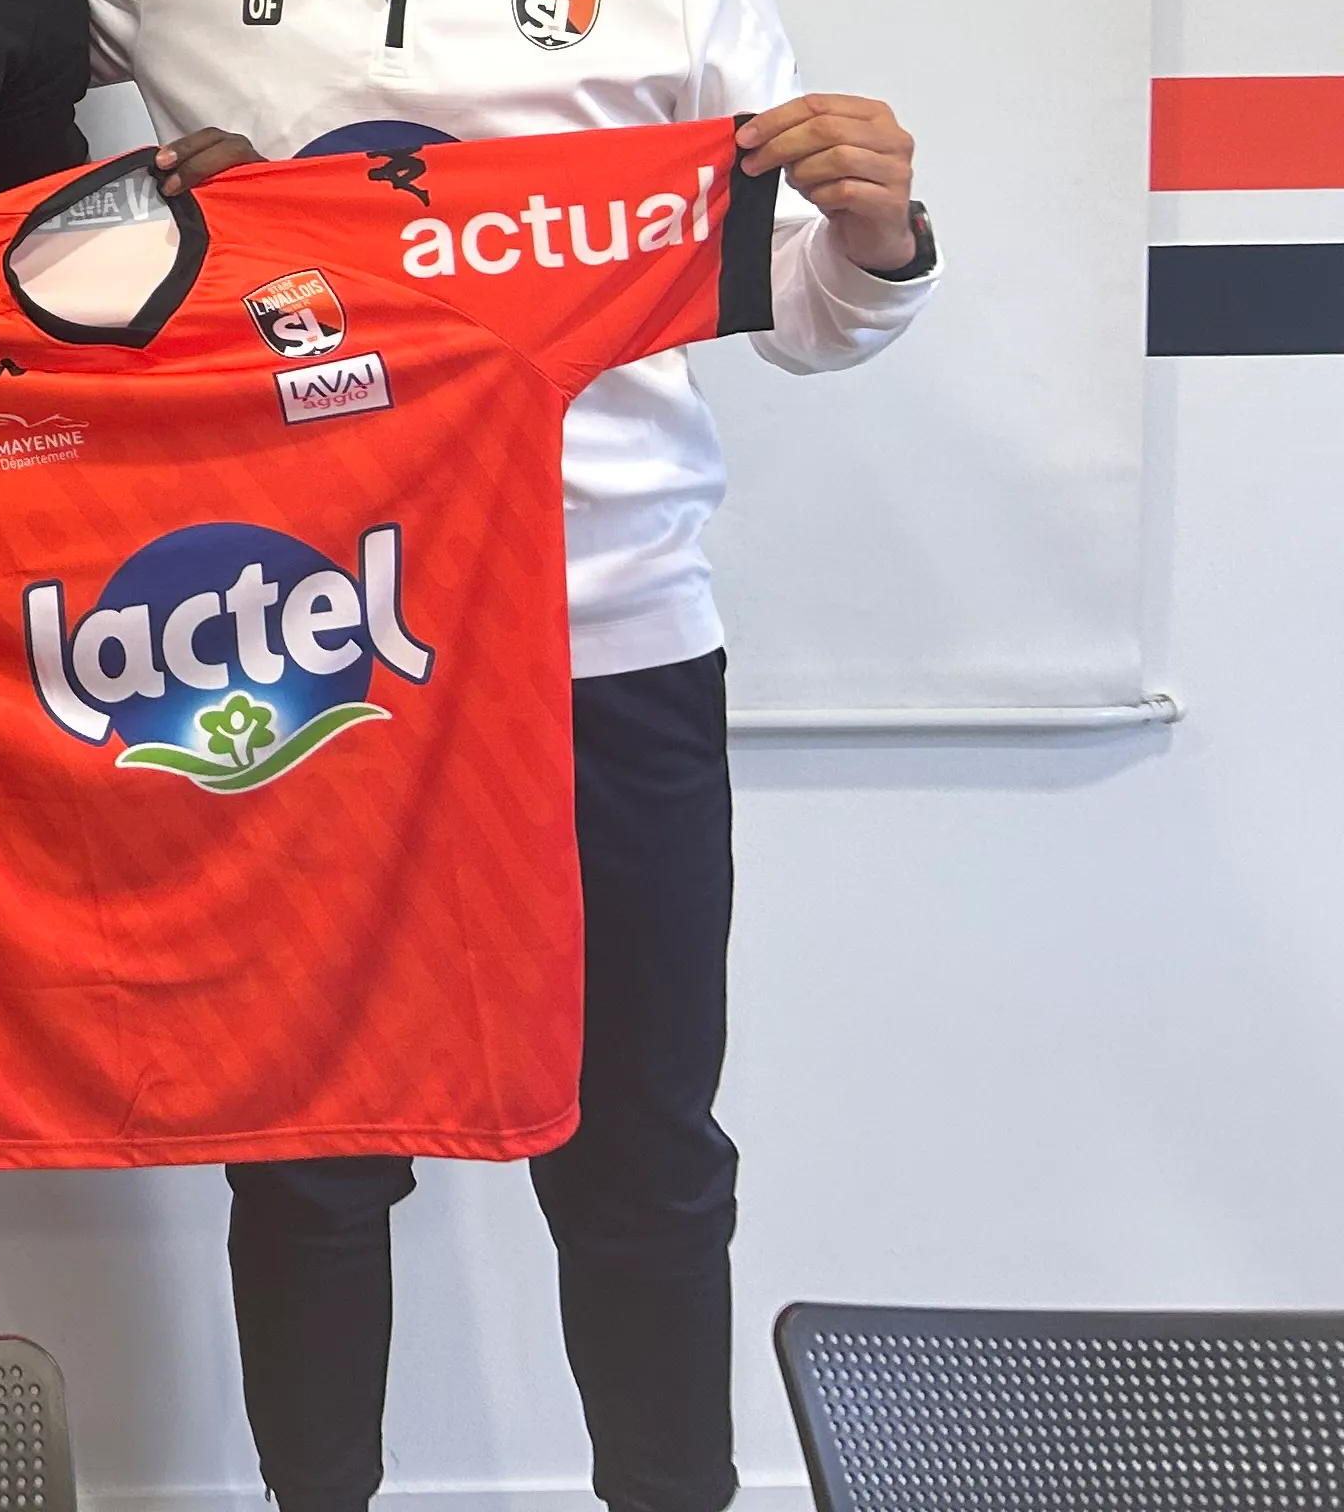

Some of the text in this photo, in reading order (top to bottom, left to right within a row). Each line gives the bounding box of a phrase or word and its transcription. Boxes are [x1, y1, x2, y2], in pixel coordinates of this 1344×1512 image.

[400, 165, 714, 279] actual
[252, 279, 324, 316] LAVALLOIS
[267, 279, 295, 295] STADE
[303, 390, 368, 410] agglo
[0, 448, 79, 471] Département
[26, 526, 432, 743] lactel
